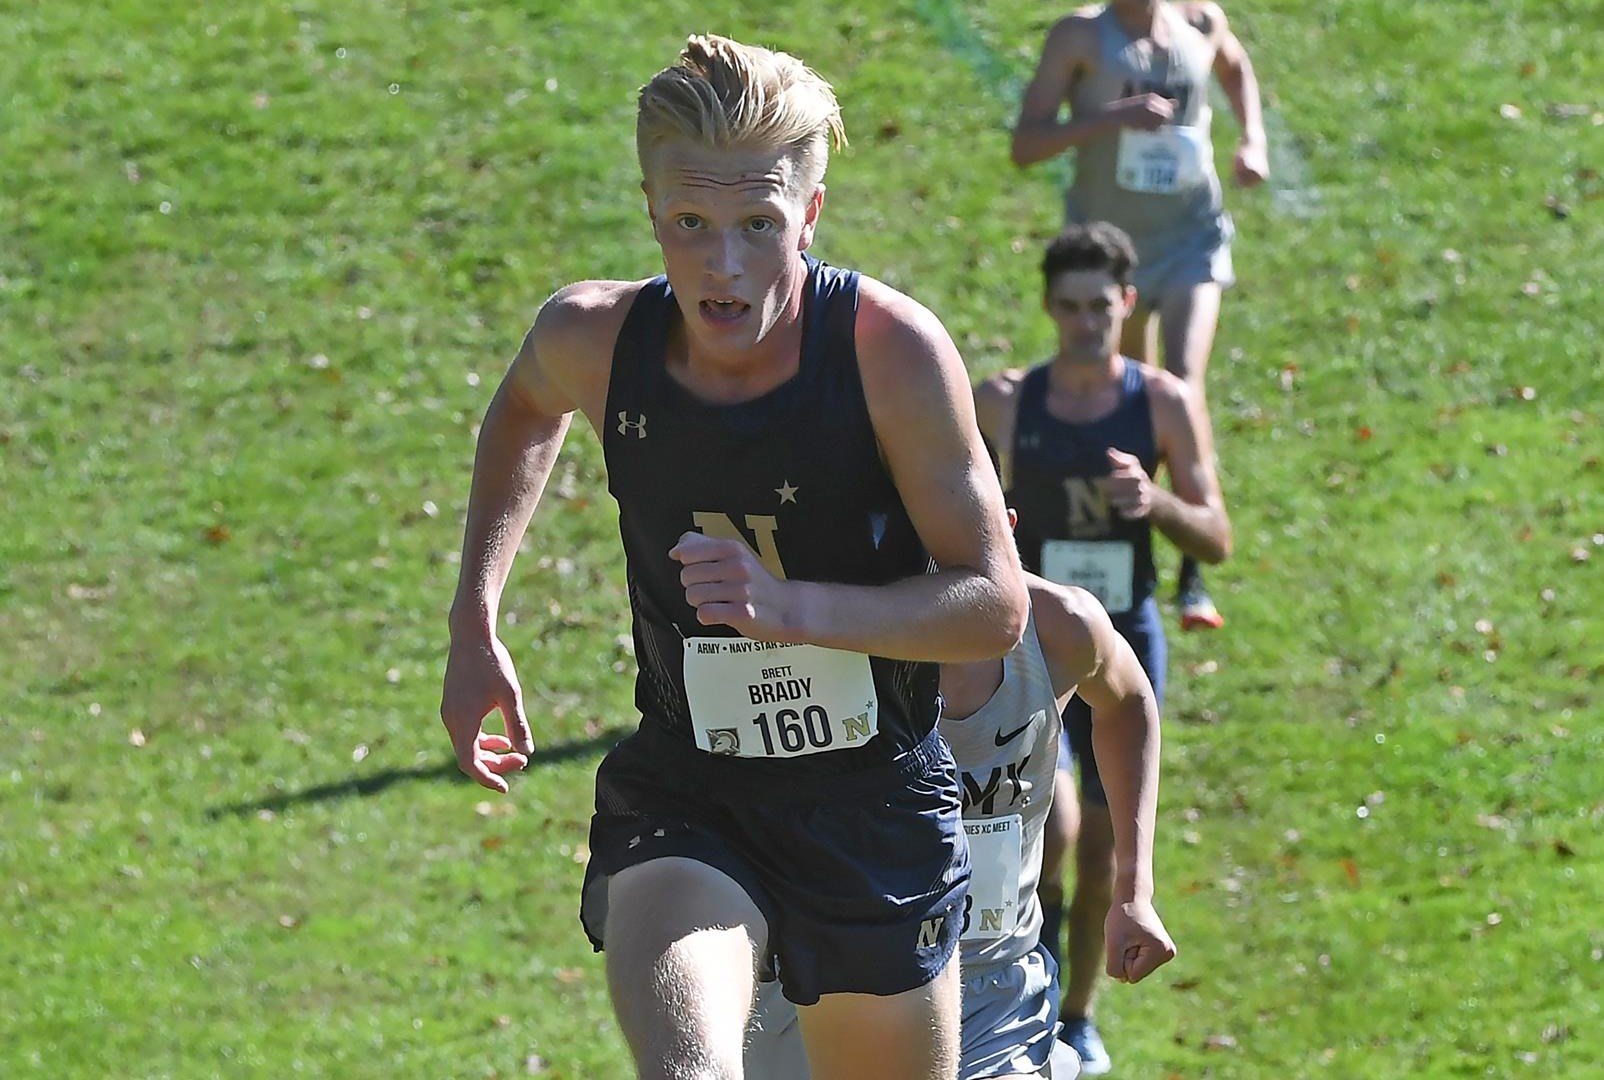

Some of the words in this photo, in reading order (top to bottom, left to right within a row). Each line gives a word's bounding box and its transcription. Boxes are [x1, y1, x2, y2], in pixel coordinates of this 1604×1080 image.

[697, 643, 720, 654] ARMY
[729, 642, 752, 654] NAVY
[761, 665, 793, 680] BRETT
[748, 677, 813, 705] BRADY
[752, 705, 833, 756] 160
[842, 712, 871, 742] N
[981, 823, 992, 834] XC
[993, 821, 1010, 833] MEET
[916, 917, 945, 949] N
[979, 908, 1005, 932] N
